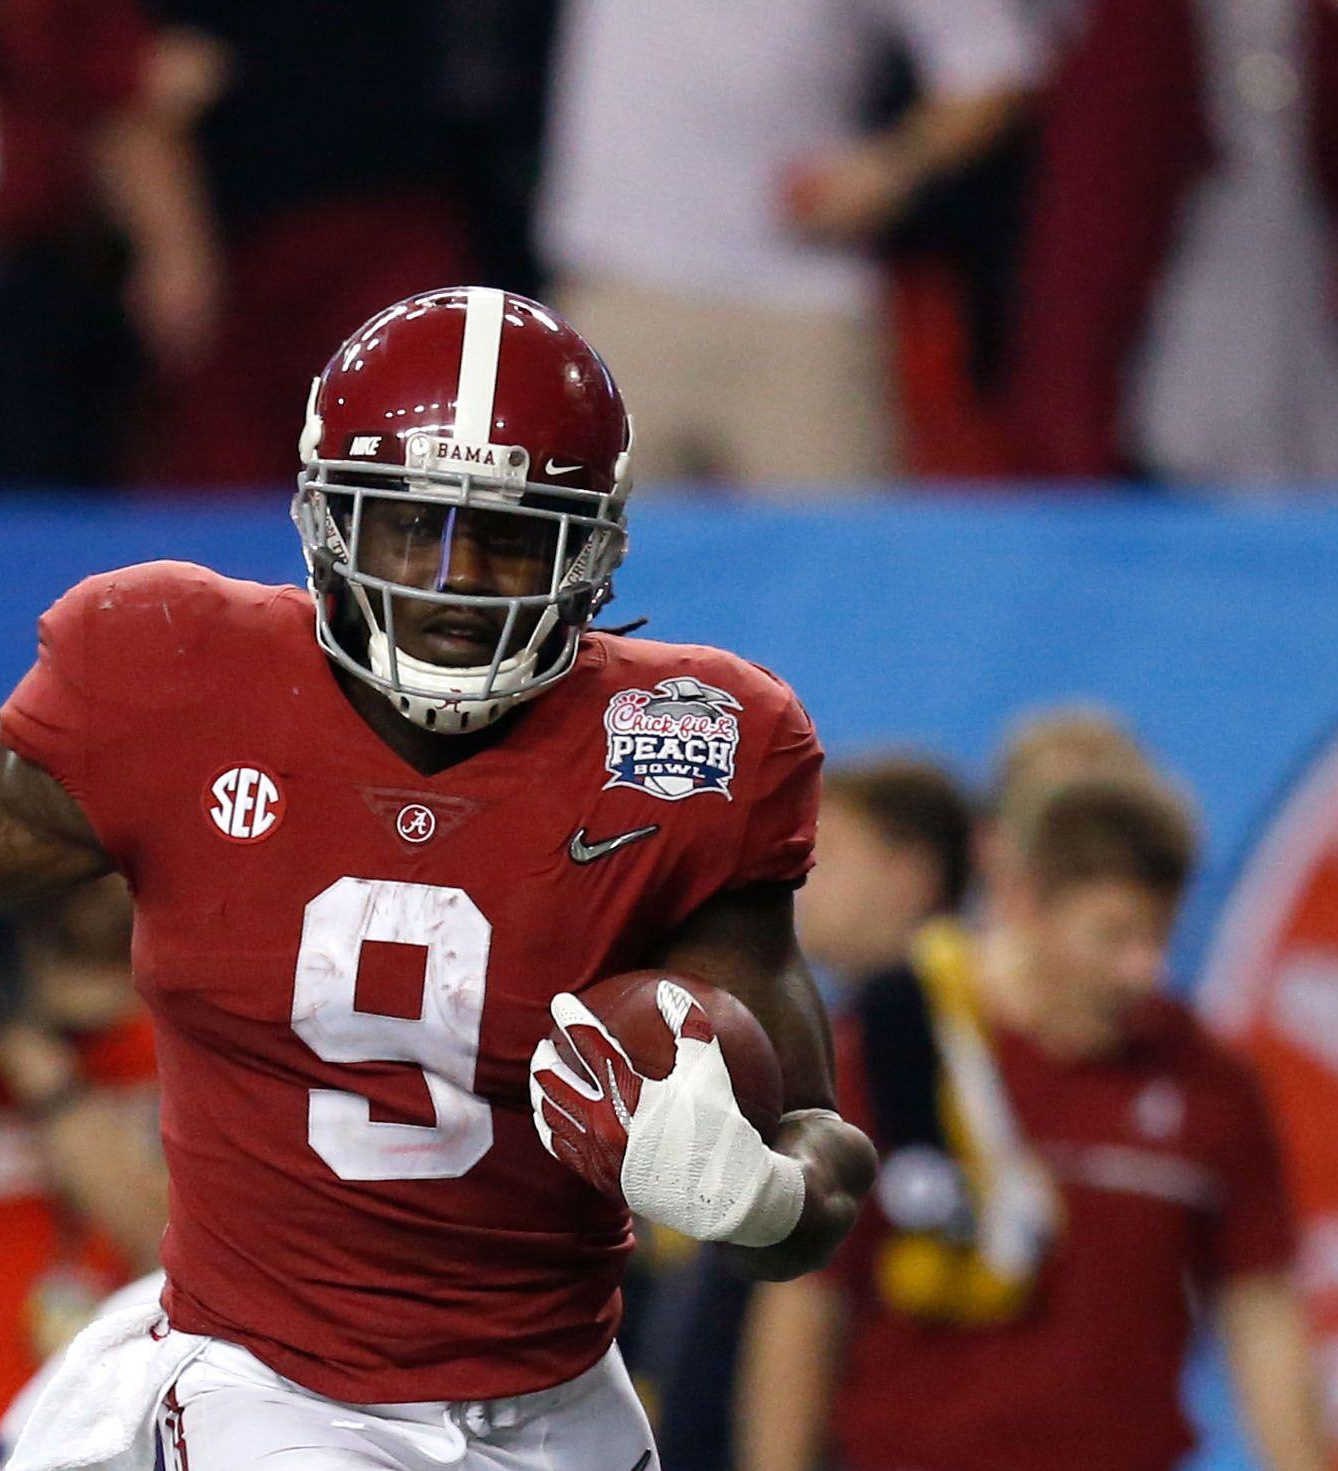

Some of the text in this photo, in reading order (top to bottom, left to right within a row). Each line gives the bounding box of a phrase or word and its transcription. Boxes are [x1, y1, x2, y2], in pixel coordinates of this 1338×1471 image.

[349, 436, 382, 456] NIKE
[437, 442, 495, 466] BAMA
[612, 736, 732, 772] PEACH
[634, 763, 706, 778] BOWL
[210, 767, 280, 838] SEC
[291, 876, 494, 1181] 9
